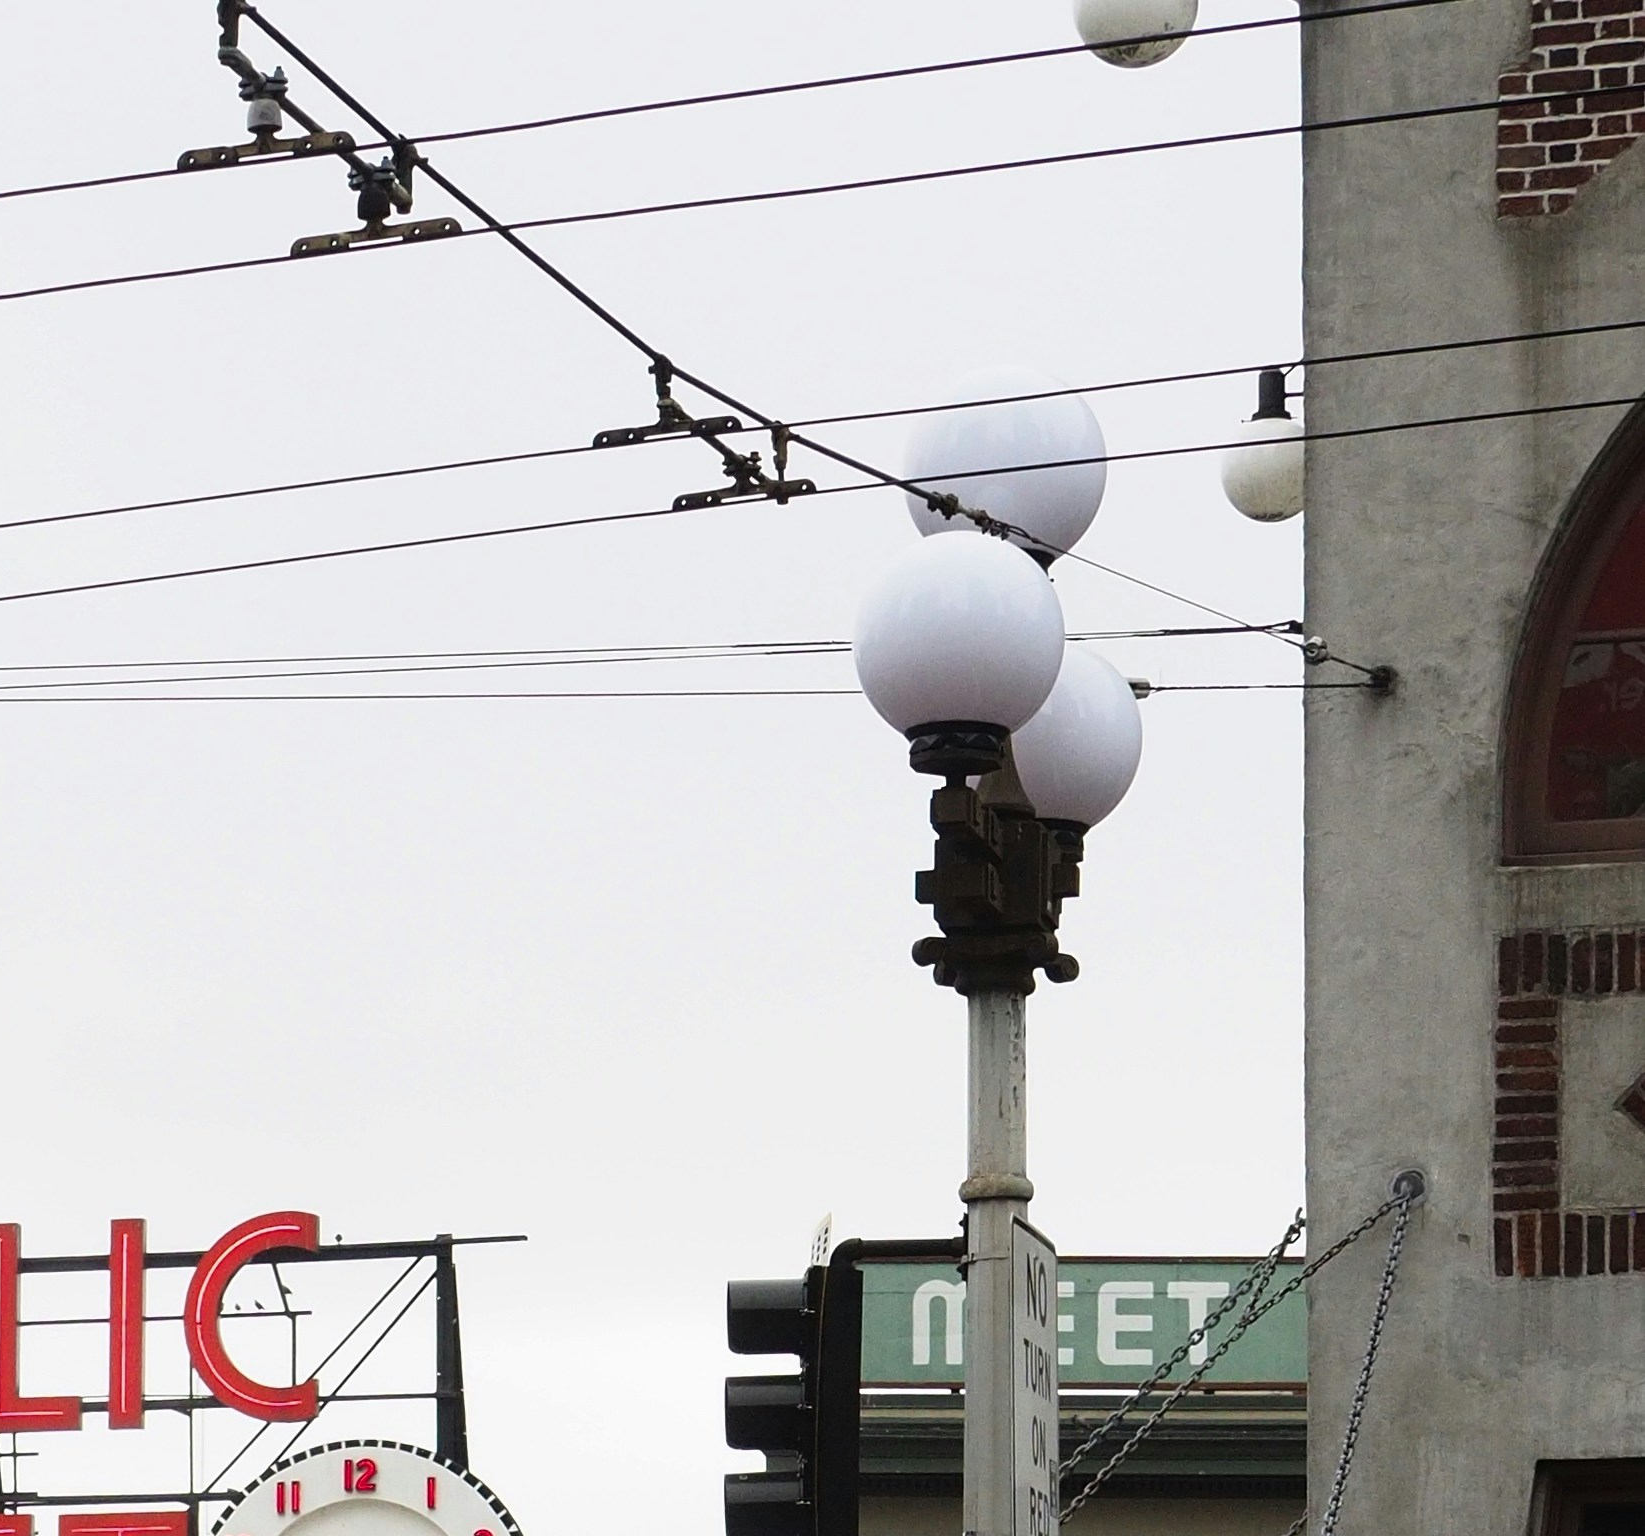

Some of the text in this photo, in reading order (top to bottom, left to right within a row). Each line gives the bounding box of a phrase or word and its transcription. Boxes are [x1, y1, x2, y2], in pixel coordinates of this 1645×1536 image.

[1026, 1253, 1049, 1327] NO
[1022, 1337, 1052, 1403] TURN
[1033, 1416, 1047, 1470] ON
[276, 1481, 301, 1515] 11
[344, 1459, 378, 1493] 12
[427, 1477, 436, 1510] 1
